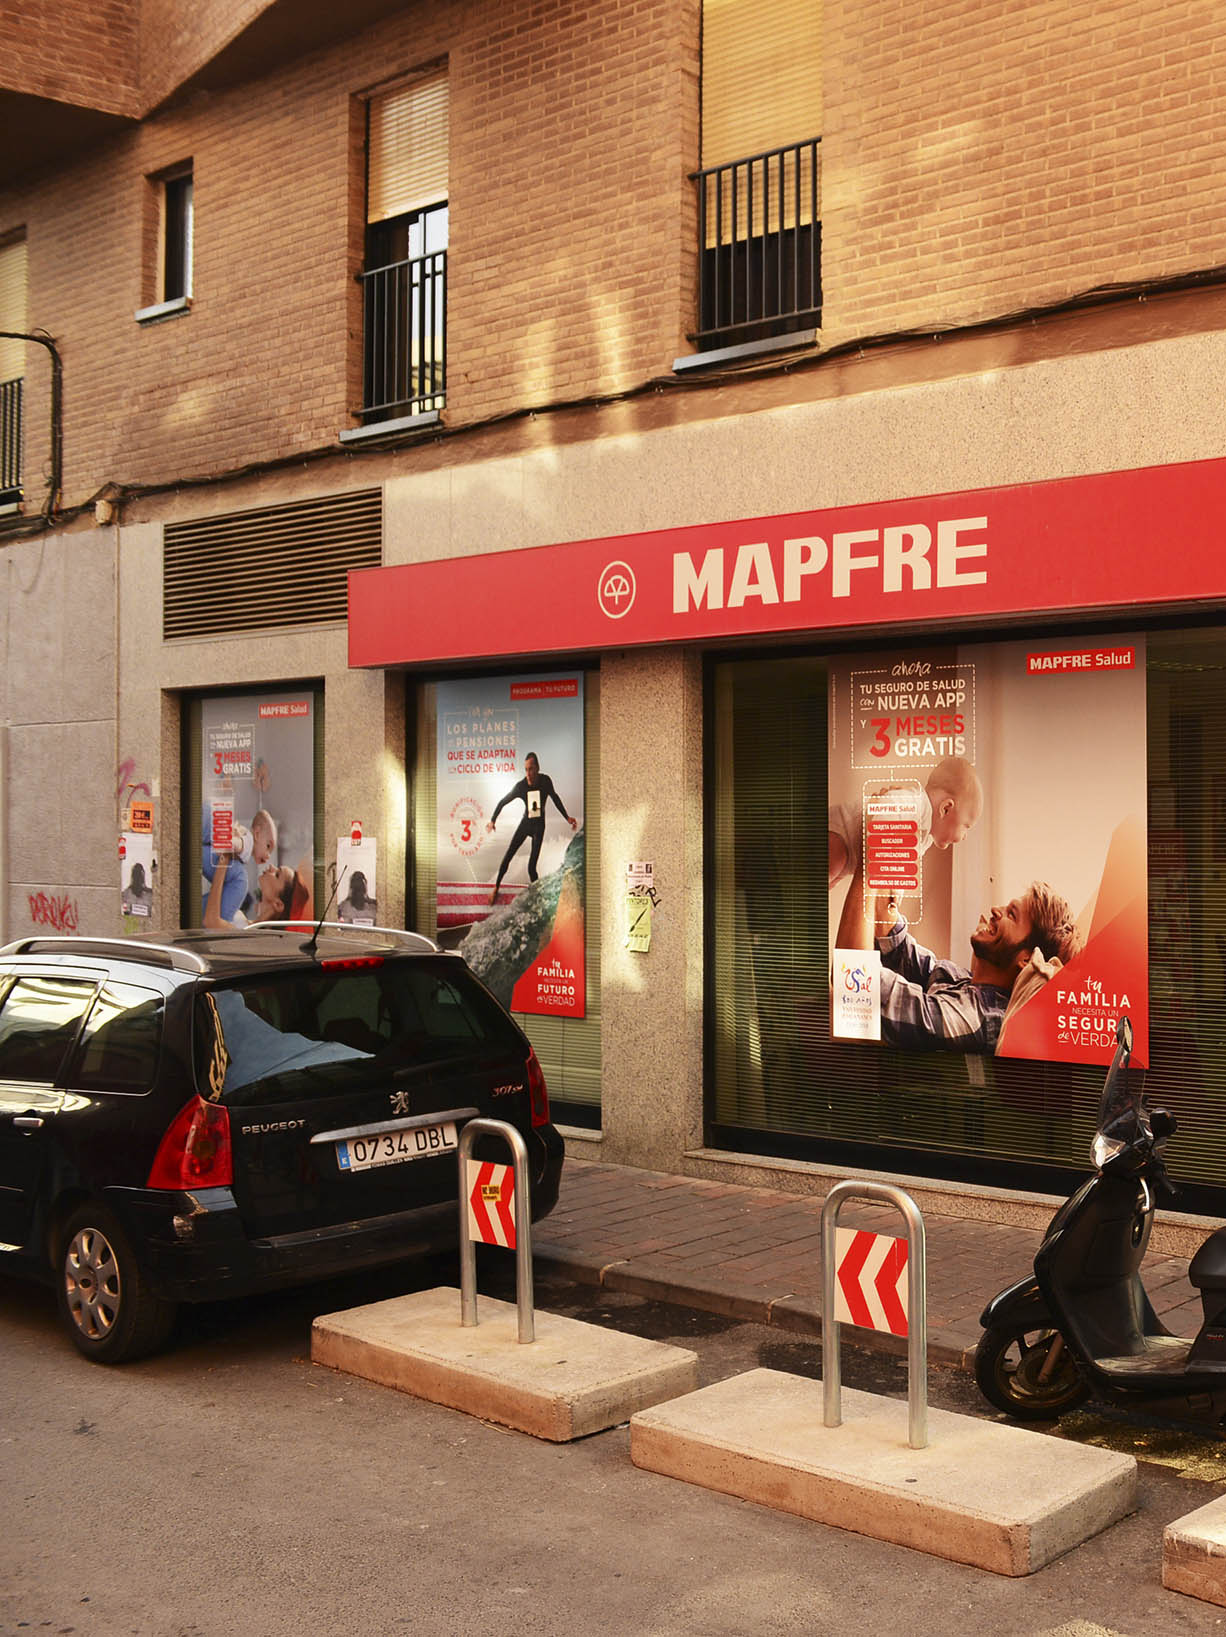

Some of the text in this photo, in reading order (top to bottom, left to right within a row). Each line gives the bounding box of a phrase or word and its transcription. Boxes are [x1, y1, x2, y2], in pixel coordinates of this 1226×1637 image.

[673, 516, 988, 613] MAPFRE
[1030, 651, 1131, 670] MAPFRE Salud
[891, 661, 931, 676] ahora
[860, 679, 966, 694] TU SEGURO DE SALUD
[261, 703, 307, 715] MAPFRE Salud
[878, 694, 930, 711] NUEVA
[934, 692, 966, 708] APP
[448, 721, 516, 735] LOS PLANES
[860, 720, 866, 728] Y
[896, 714, 965, 736] MESES
[216, 739, 238, 749] NUEVA
[239, 738, 251, 748] APP
[456, 735, 516, 748] PENSIONES
[869, 717, 891, 758] 3
[895, 736, 966, 757] GRATIS
[224, 752, 251, 763] MESES
[447, 748, 516, 761] QUE SE ADAPTAN
[213, 752, 223, 774] 3
[224, 763, 251, 774] GRATIS
[457, 763, 480, 774] CICLO
[483, 763, 494, 773] DE
[496, 762, 516, 772] VIDA
[537, 966, 575, 978] FAMILIA
[537, 984, 575, 996] FUTURO
[1084, 976, 1102, 993] tu
[543, 994, 575, 1007] VERDAD
[1057, 990, 1131, 1008] FAMILIA
[1072, 1007, 1106, 1016] NECESITA
[1058, 1015, 1117, 1032] SEGUR
[1070, 1031, 1118, 1047] VERDA
[242, 1119, 306, 1135] PEUGEOT
[354, 1134, 409, 1162] 0734
[415, 1127, 454, 1151] DBL
